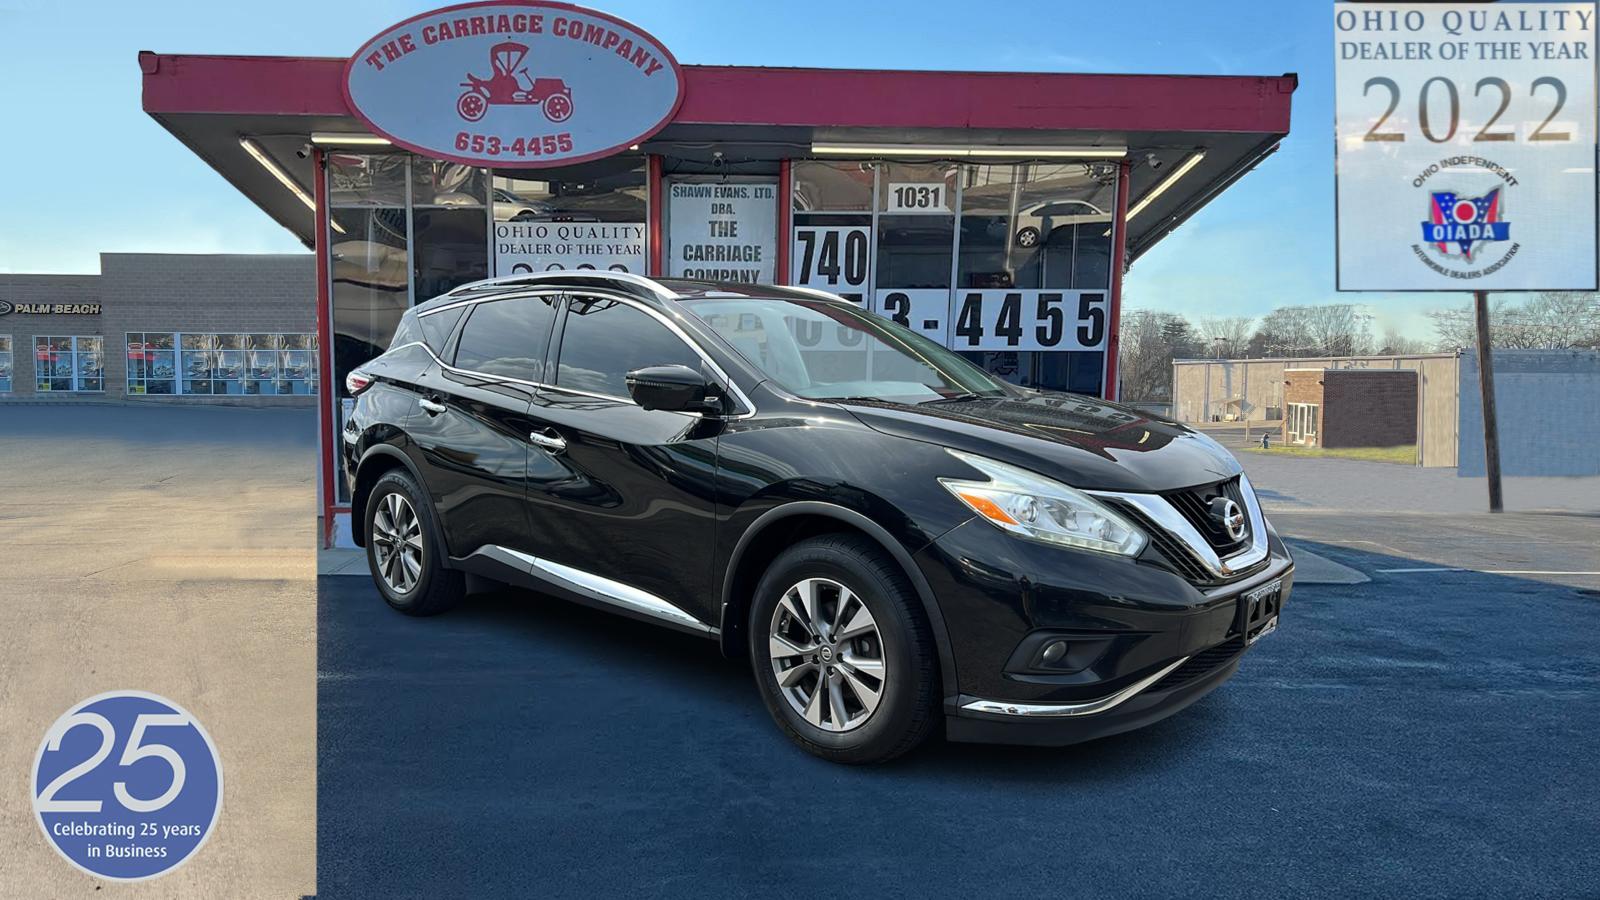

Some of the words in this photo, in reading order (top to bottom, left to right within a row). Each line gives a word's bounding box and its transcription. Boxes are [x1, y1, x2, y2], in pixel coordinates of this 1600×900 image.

[1336, 10, 1425, 31] OHIO
[1442, 10, 1592, 36] QUALITY
[365, 34, 416, 72] THE
[422, 14, 544, 46] CARRIAGE
[552, 16, 664, 77] COMPANY
[1340, 42, 1433, 60] DEALER
[1438, 42, 1469, 60] OF
[1475, 42, 1521, 60] THE
[1528, 42, 1589, 60] YEAR
[1363, 76, 1570, 143] 2022
[454, 132, 573, 156] 653-4455
[1412, 164, 1439, 188] OHIO
[1440, 156, 1519, 188] INDEPENDENT
[673, 186, 711, 198] SHAWN
[754, 187, 774, 199] LTD.
[894, 187, 940, 208] 1031
[711, 203, 735, 214] DBA.
[497, 226, 548, 238] OHIO
[557, 226, 643, 240] QUALITY
[709, 221, 737, 237] THE
[1432, 224, 1495, 240] OIADA
[500, 244, 551, 255] DEALER
[555, 244, 573, 255] OF
[576, 244, 602, 255] THE
[607, 244, 641, 255] YEAR
[683, 244, 762, 262] CARRIAGE
[797, 230, 868, 285] 740
[683, 269, 761, 284] COMPANY
